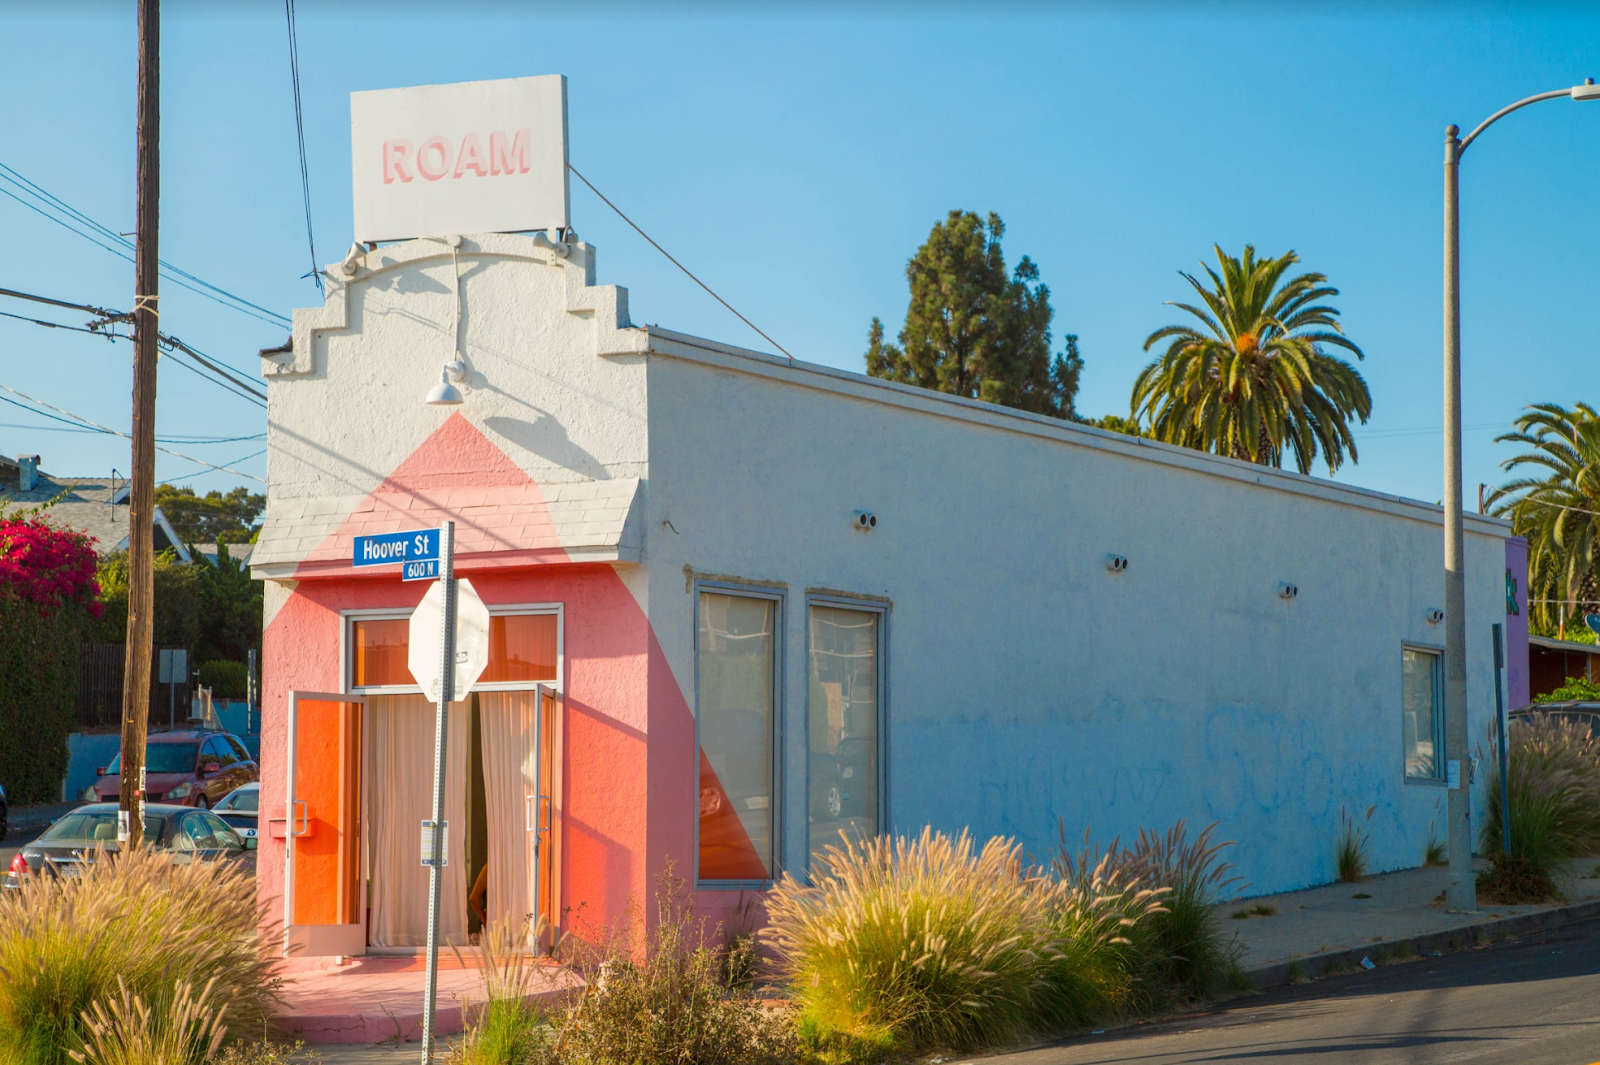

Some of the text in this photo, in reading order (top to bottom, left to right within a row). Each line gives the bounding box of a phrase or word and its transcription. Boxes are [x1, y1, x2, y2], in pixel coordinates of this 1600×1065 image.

[382, 128, 531, 185] ROAM
[363, 535, 429, 559] Hoover St
[408, 562, 433, 577] 600 N
